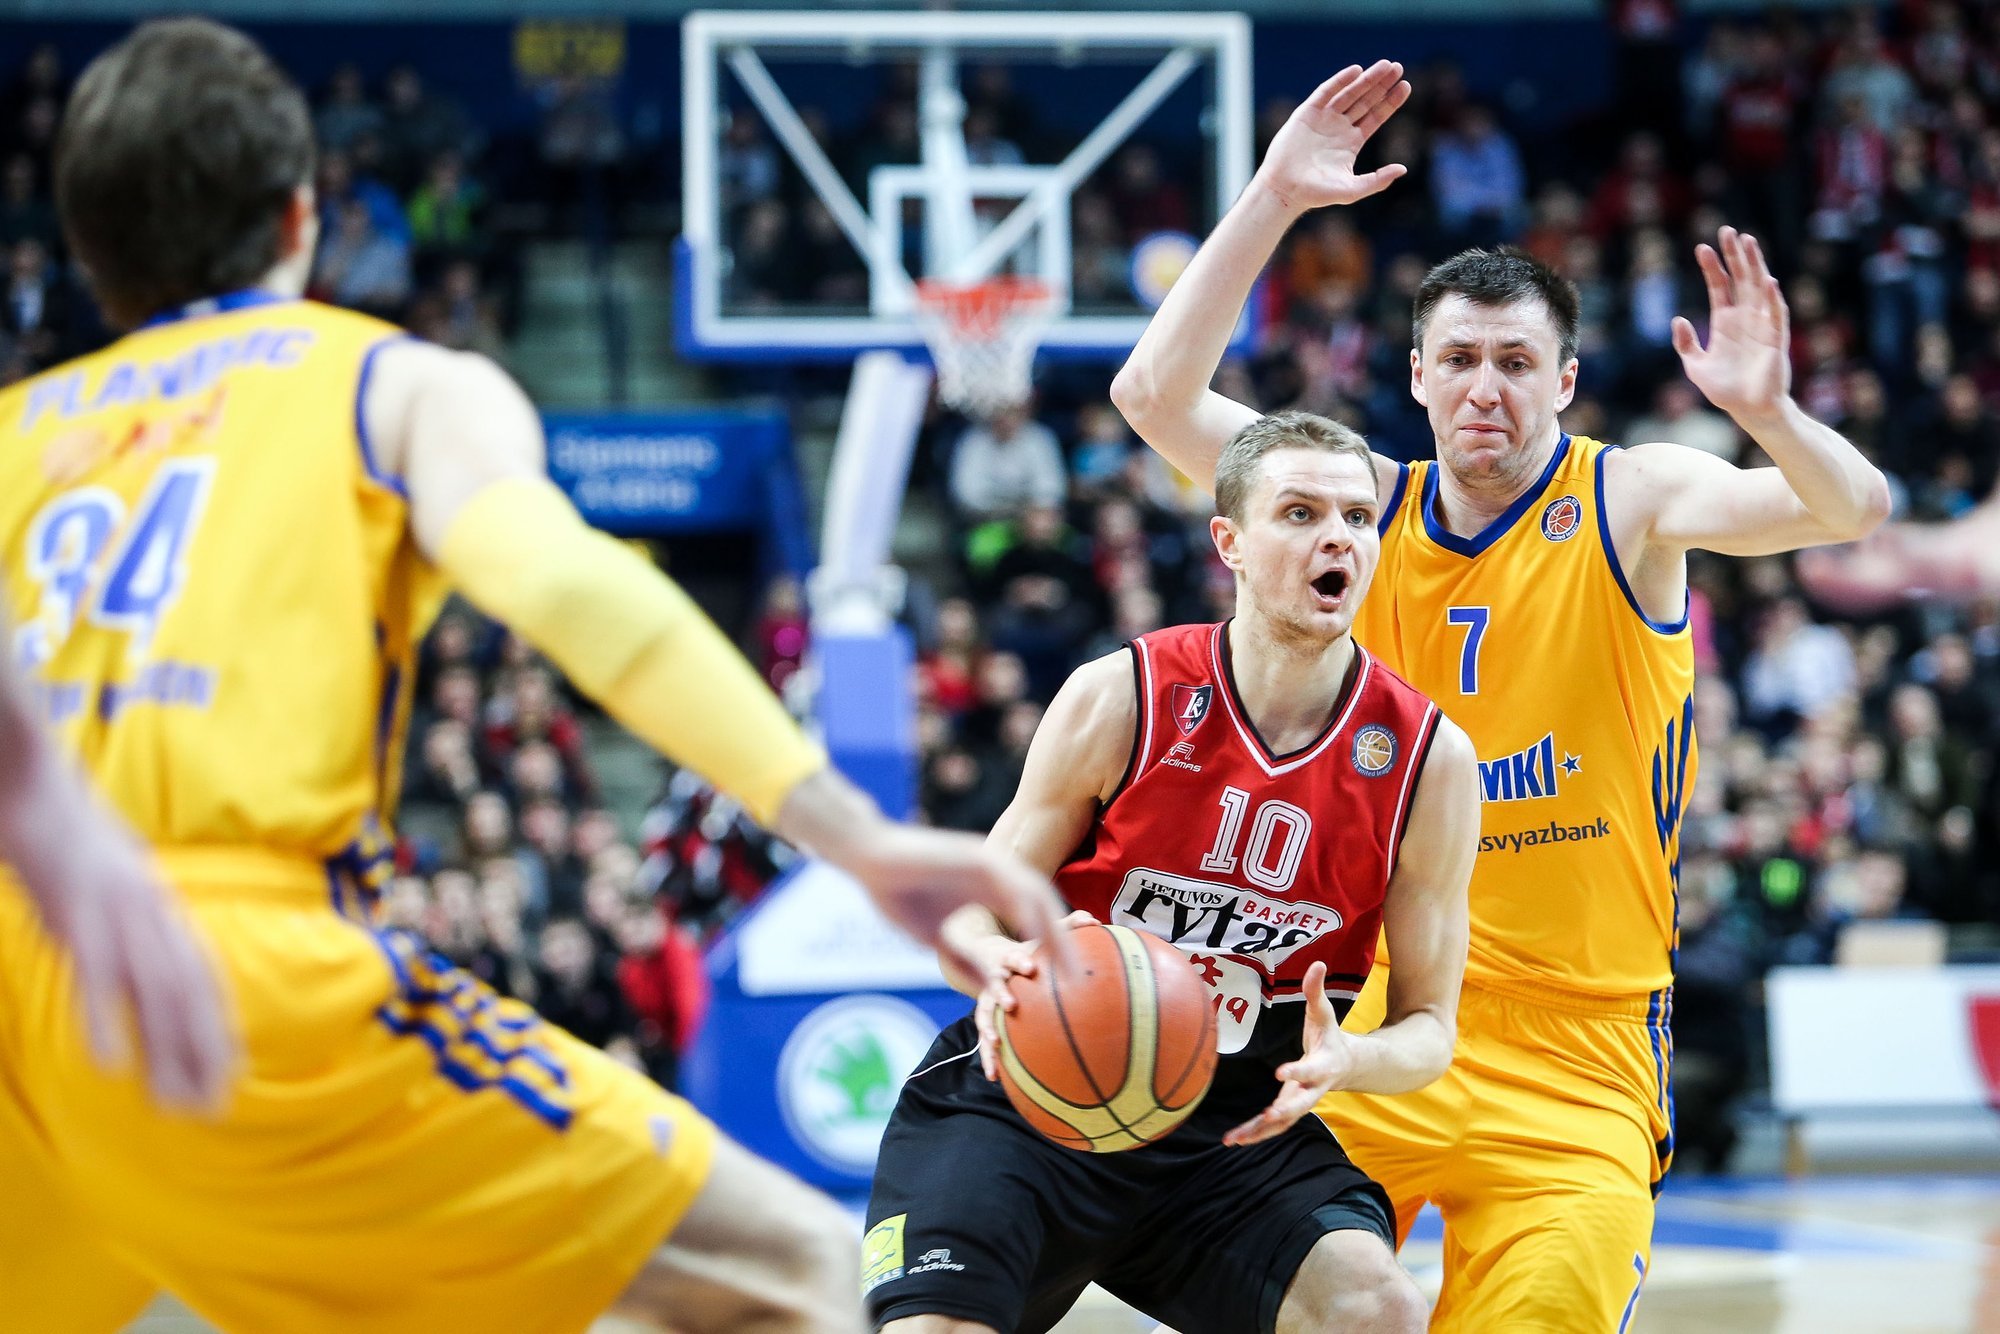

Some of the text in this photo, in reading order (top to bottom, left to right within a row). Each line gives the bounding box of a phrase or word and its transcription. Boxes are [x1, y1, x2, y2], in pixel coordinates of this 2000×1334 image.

[17, 455, 218, 668] 34
[1446, 605, 1490, 696] 7
[1200, 785, 1312, 893] 10
[1477, 817, 1610, 853] svyazbank
[1140, 878, 1225, 905] LIETUVOS
[1242, 899, 1329, 933] BASKET
